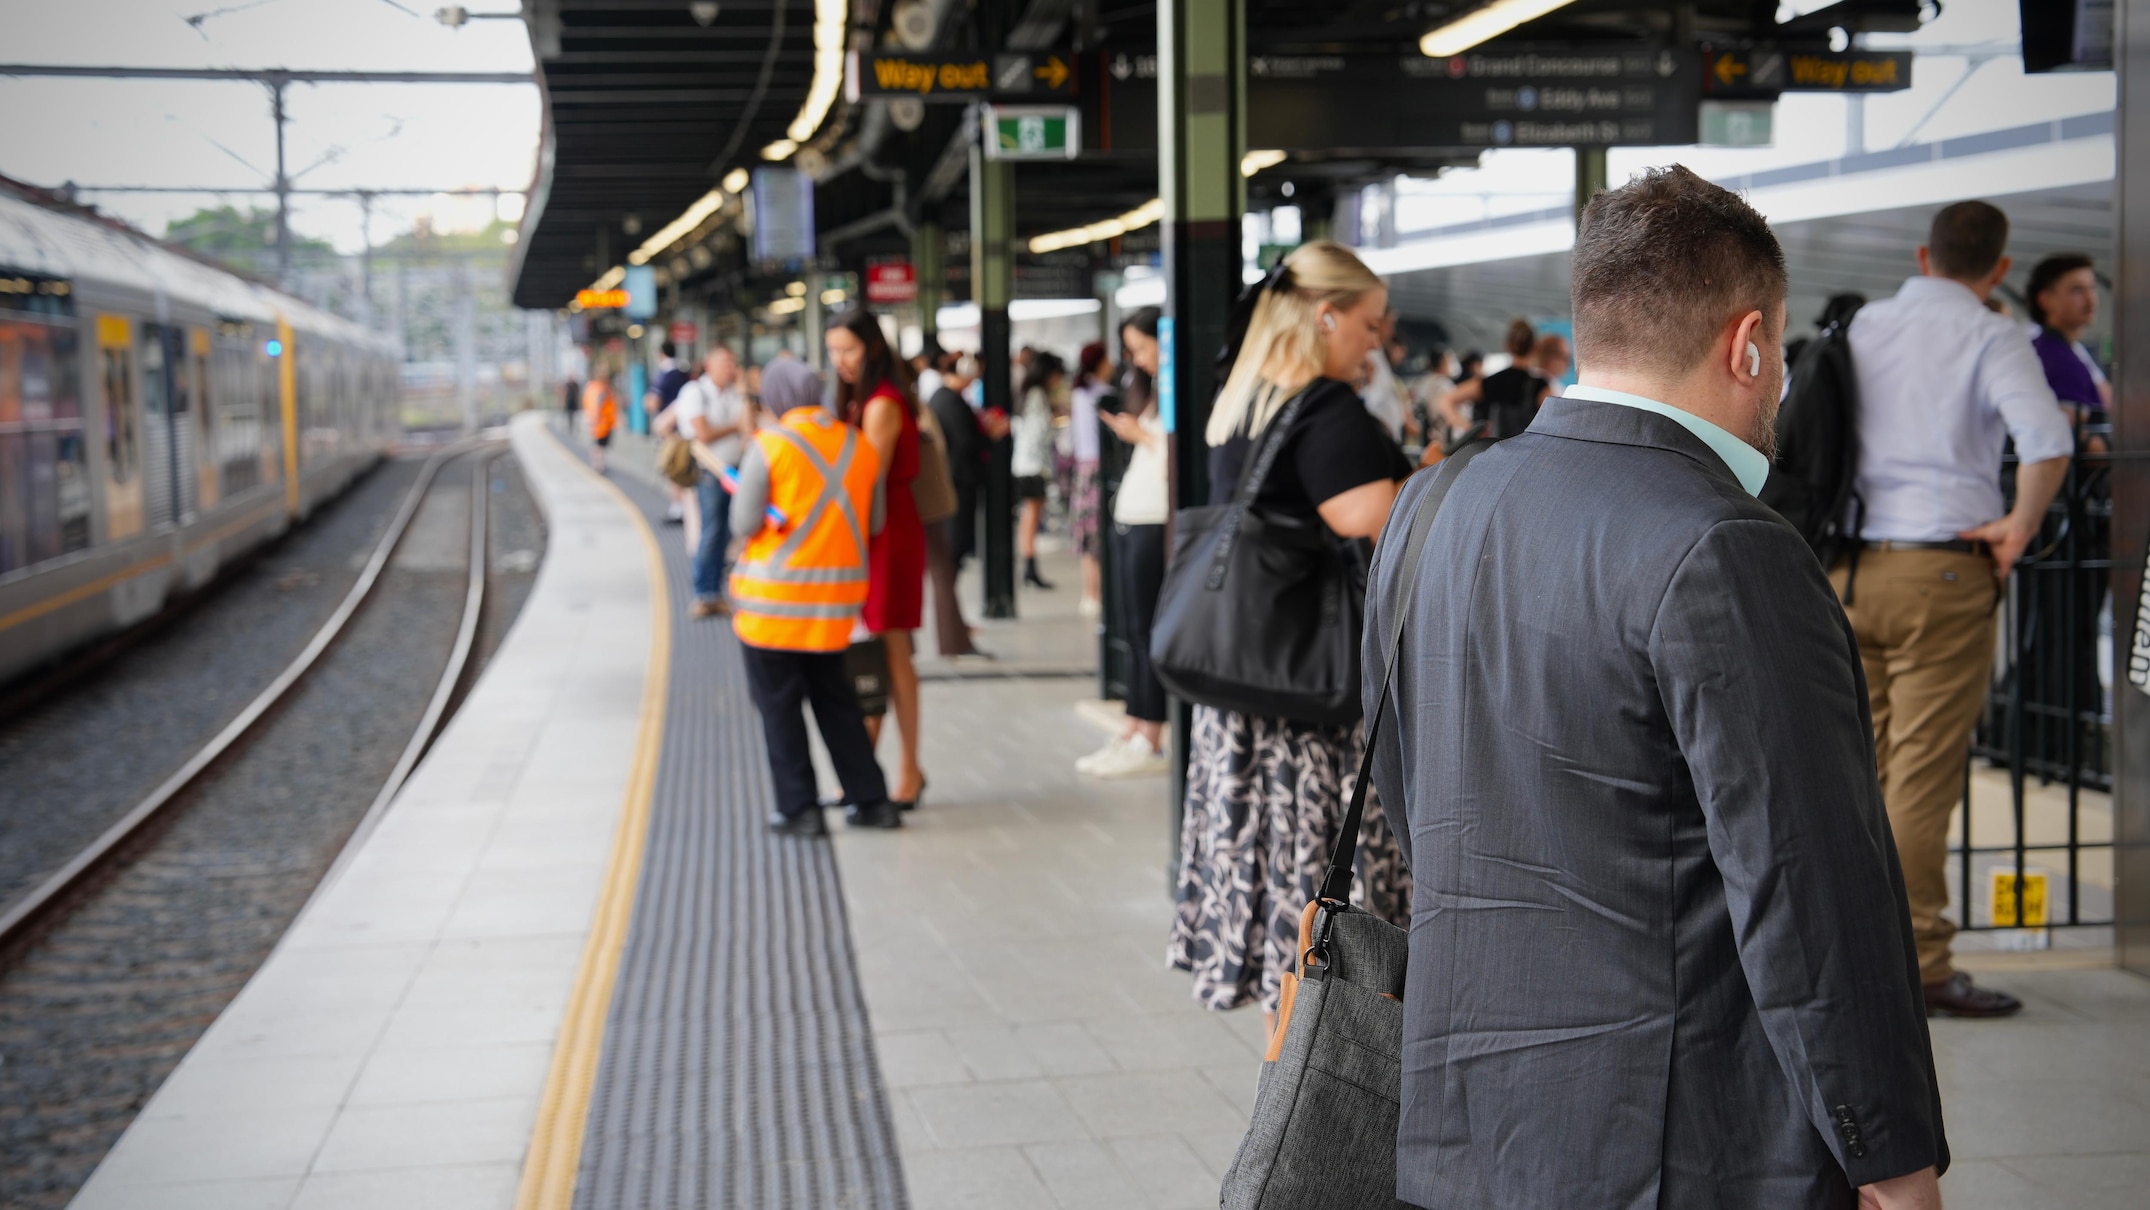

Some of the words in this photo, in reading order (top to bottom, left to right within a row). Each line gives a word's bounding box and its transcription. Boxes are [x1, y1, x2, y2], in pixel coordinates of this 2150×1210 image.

[874, 59, 937, 94] Way
[939, 61, 989, 89] out
[1790, 56, 1848, 89] Way
[1850, 58, 1897, 85] out
